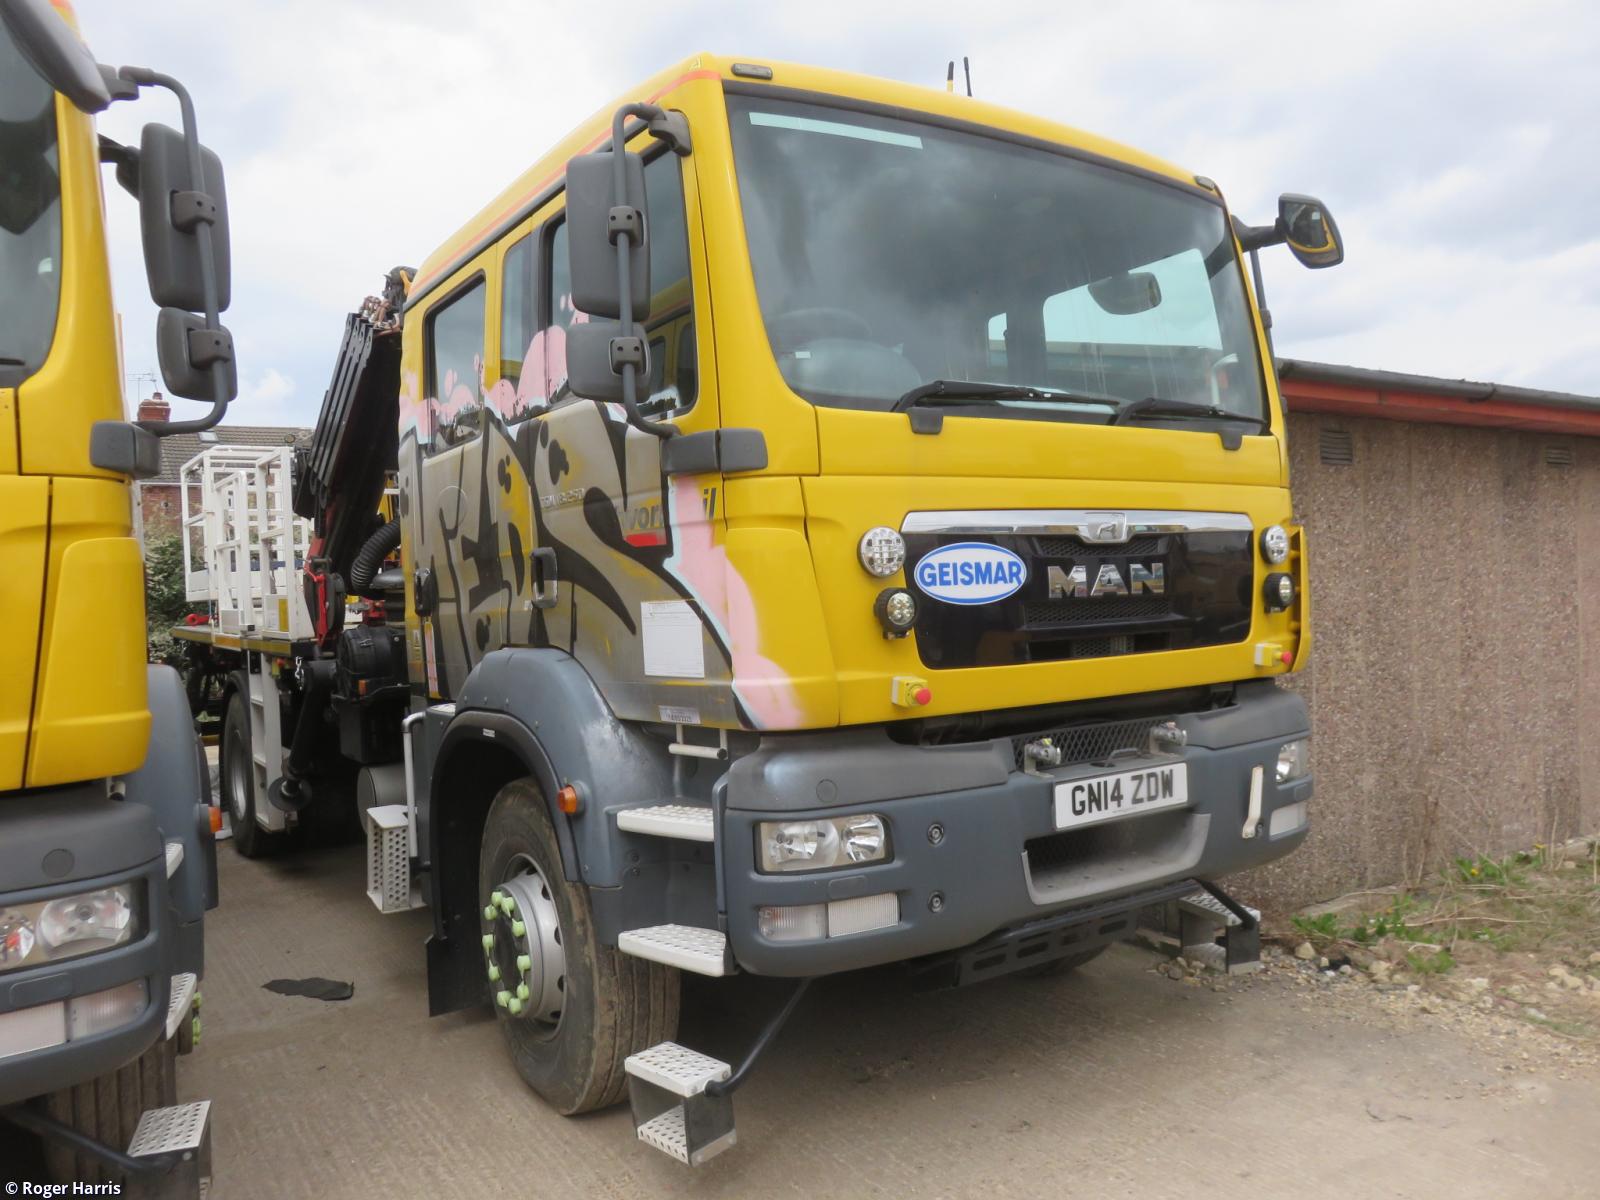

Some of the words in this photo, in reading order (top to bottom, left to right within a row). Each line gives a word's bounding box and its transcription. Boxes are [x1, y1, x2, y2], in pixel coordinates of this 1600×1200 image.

[918, 561, 1023, 588] GEISMAR
[1047, 562, 1165, 599] MAN
[1071, 778, 1124, 816] GN14
[1131, 769, 1174, 805] ZDW
